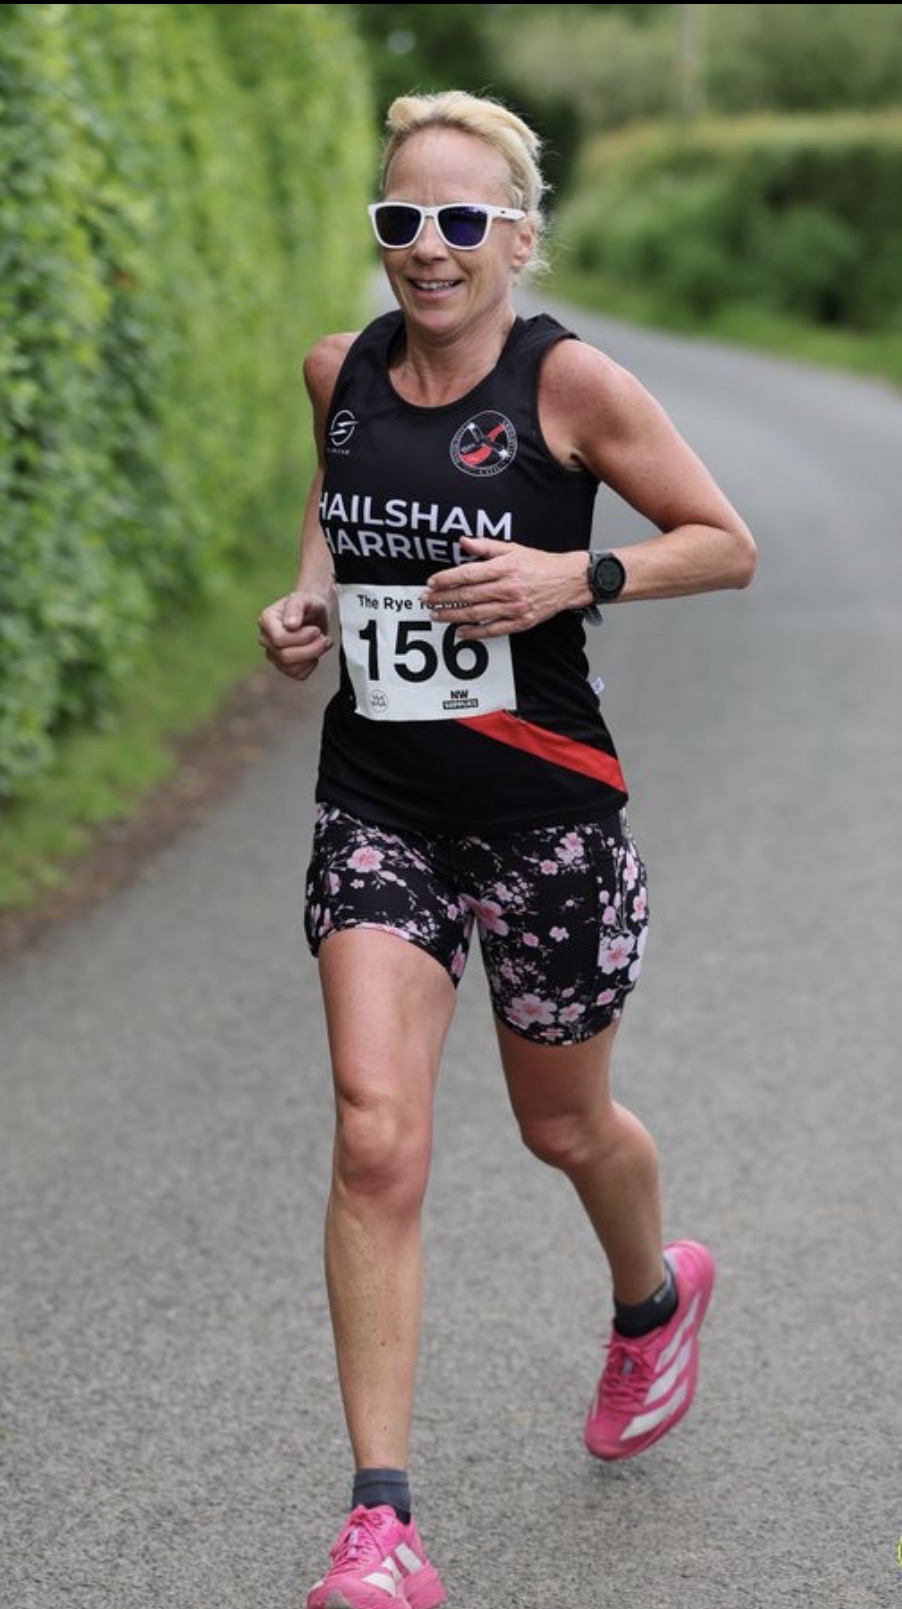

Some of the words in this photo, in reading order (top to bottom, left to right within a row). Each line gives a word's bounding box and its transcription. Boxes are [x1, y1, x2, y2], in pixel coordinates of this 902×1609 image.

[319, 491, 513, 541] HAILSHAM
[357, 594, 379, 610] The
[384, 597, 413, 612] Rye
[358, 619, 490, 684] 156
[450, 689, 469, 699] NW
